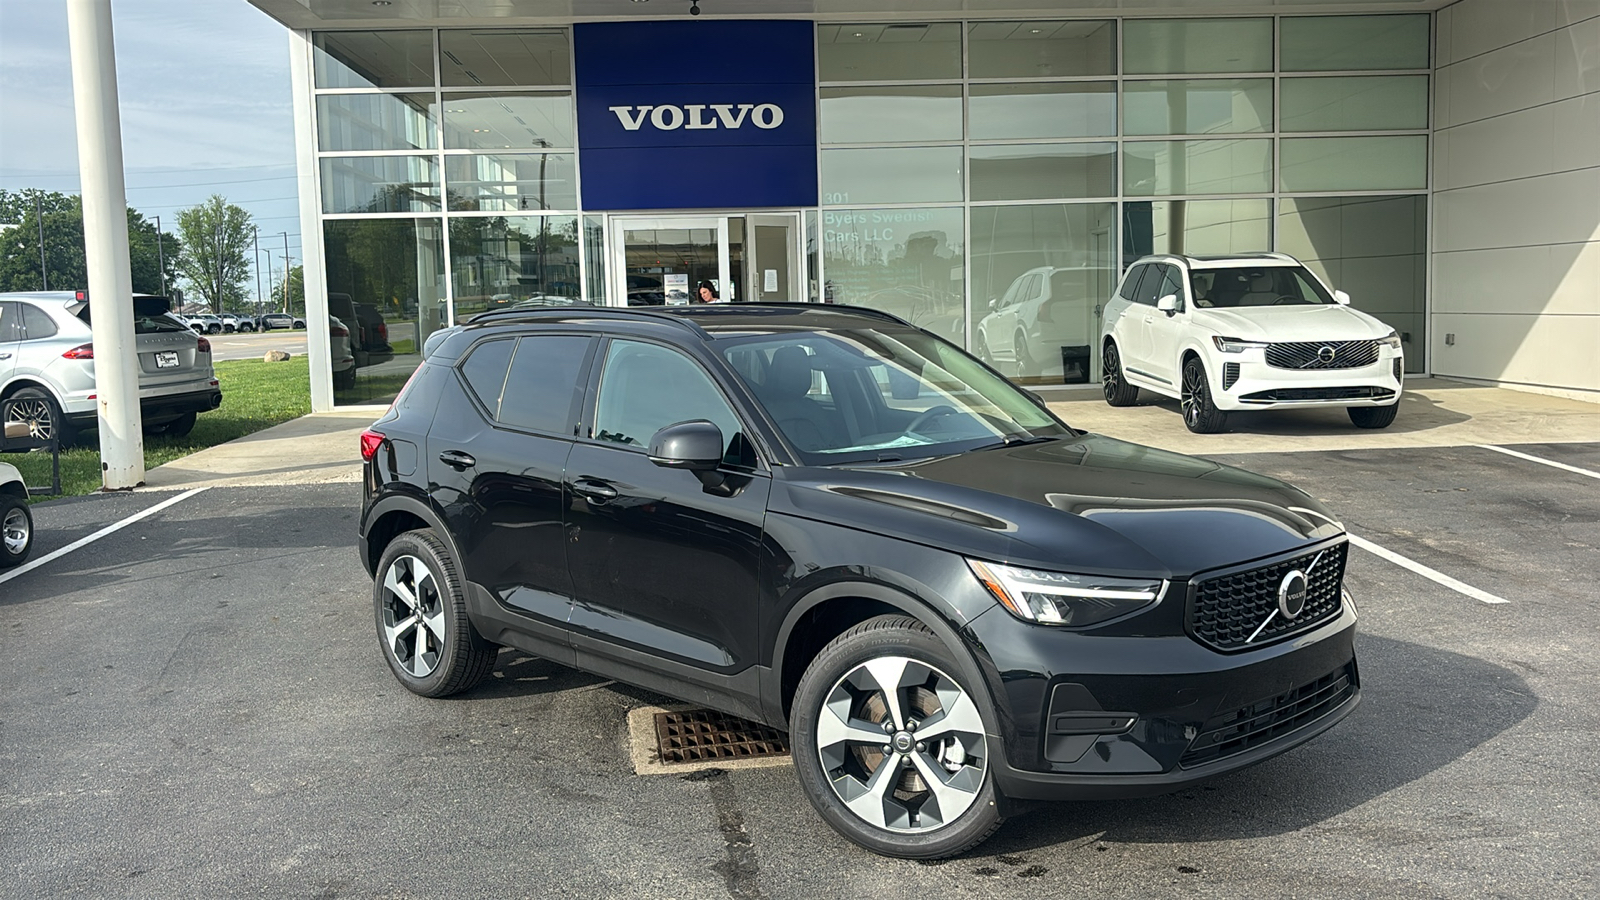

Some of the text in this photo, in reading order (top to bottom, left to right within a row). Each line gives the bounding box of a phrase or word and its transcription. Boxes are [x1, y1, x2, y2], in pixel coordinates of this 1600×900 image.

[608, 103, 784, 131] VOLVO
[824, 192, 849, 204] 301
[824, 211, 934, 227] Byers Swedish
[824, 228, 893, 242] Cars LLC
[1287, 591, 1305, 600] VOLVO
